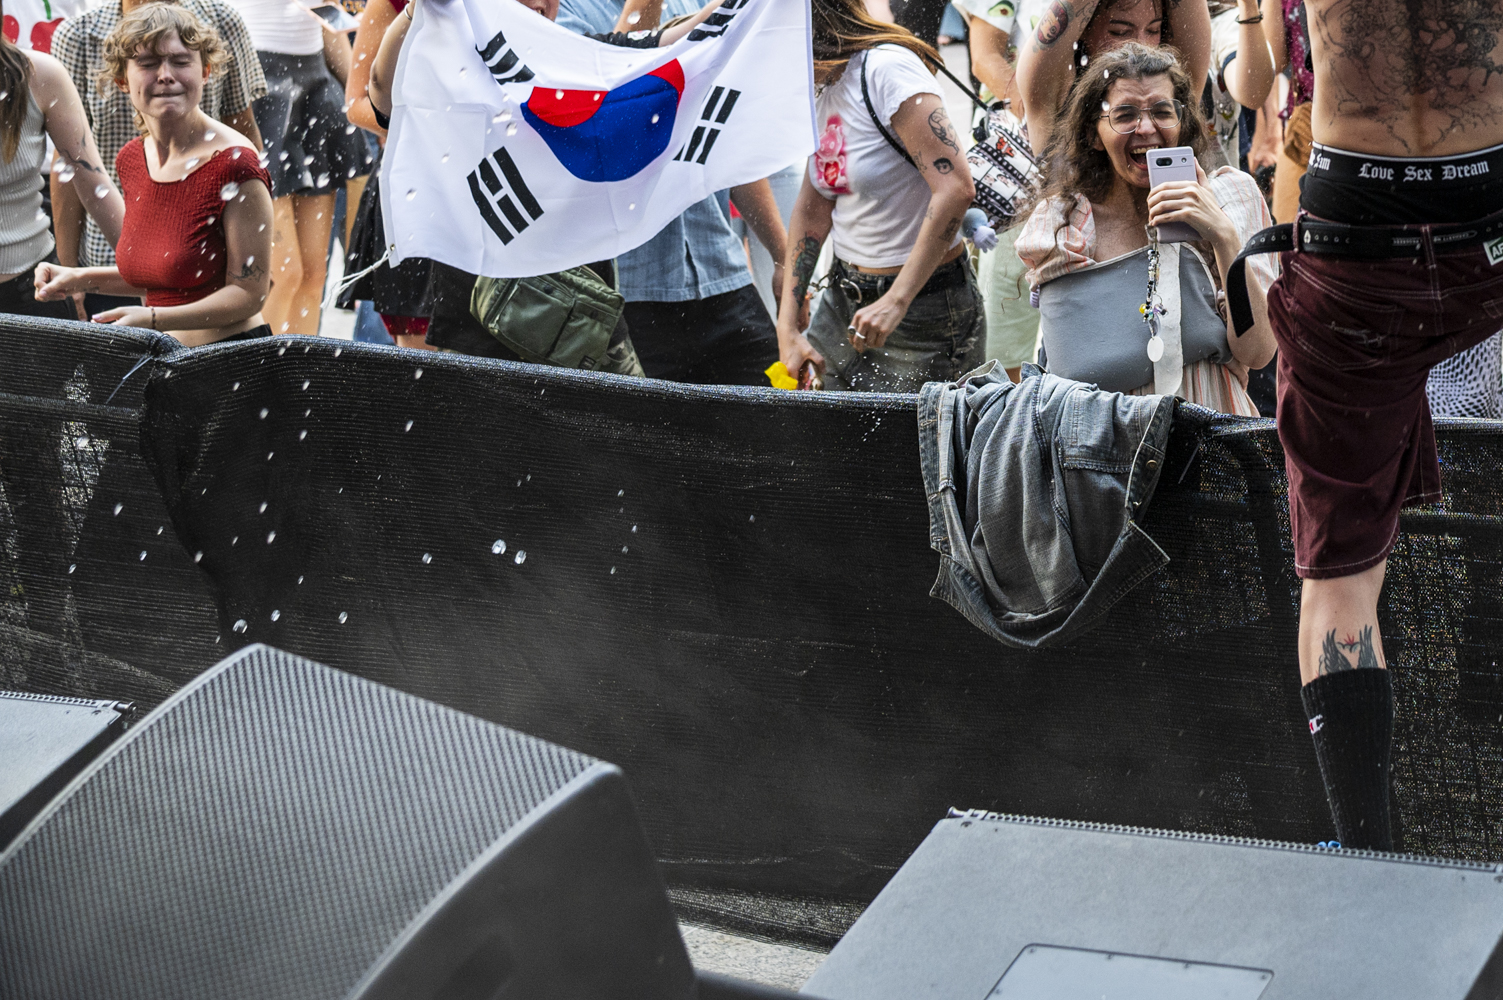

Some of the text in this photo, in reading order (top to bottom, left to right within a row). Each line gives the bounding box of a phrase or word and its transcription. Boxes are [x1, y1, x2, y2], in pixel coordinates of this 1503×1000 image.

[1357, 162, 1395, 181] Love
[1403, 165, 1432, 182] Sex
[1441, 160, 1490, 180] Dream
